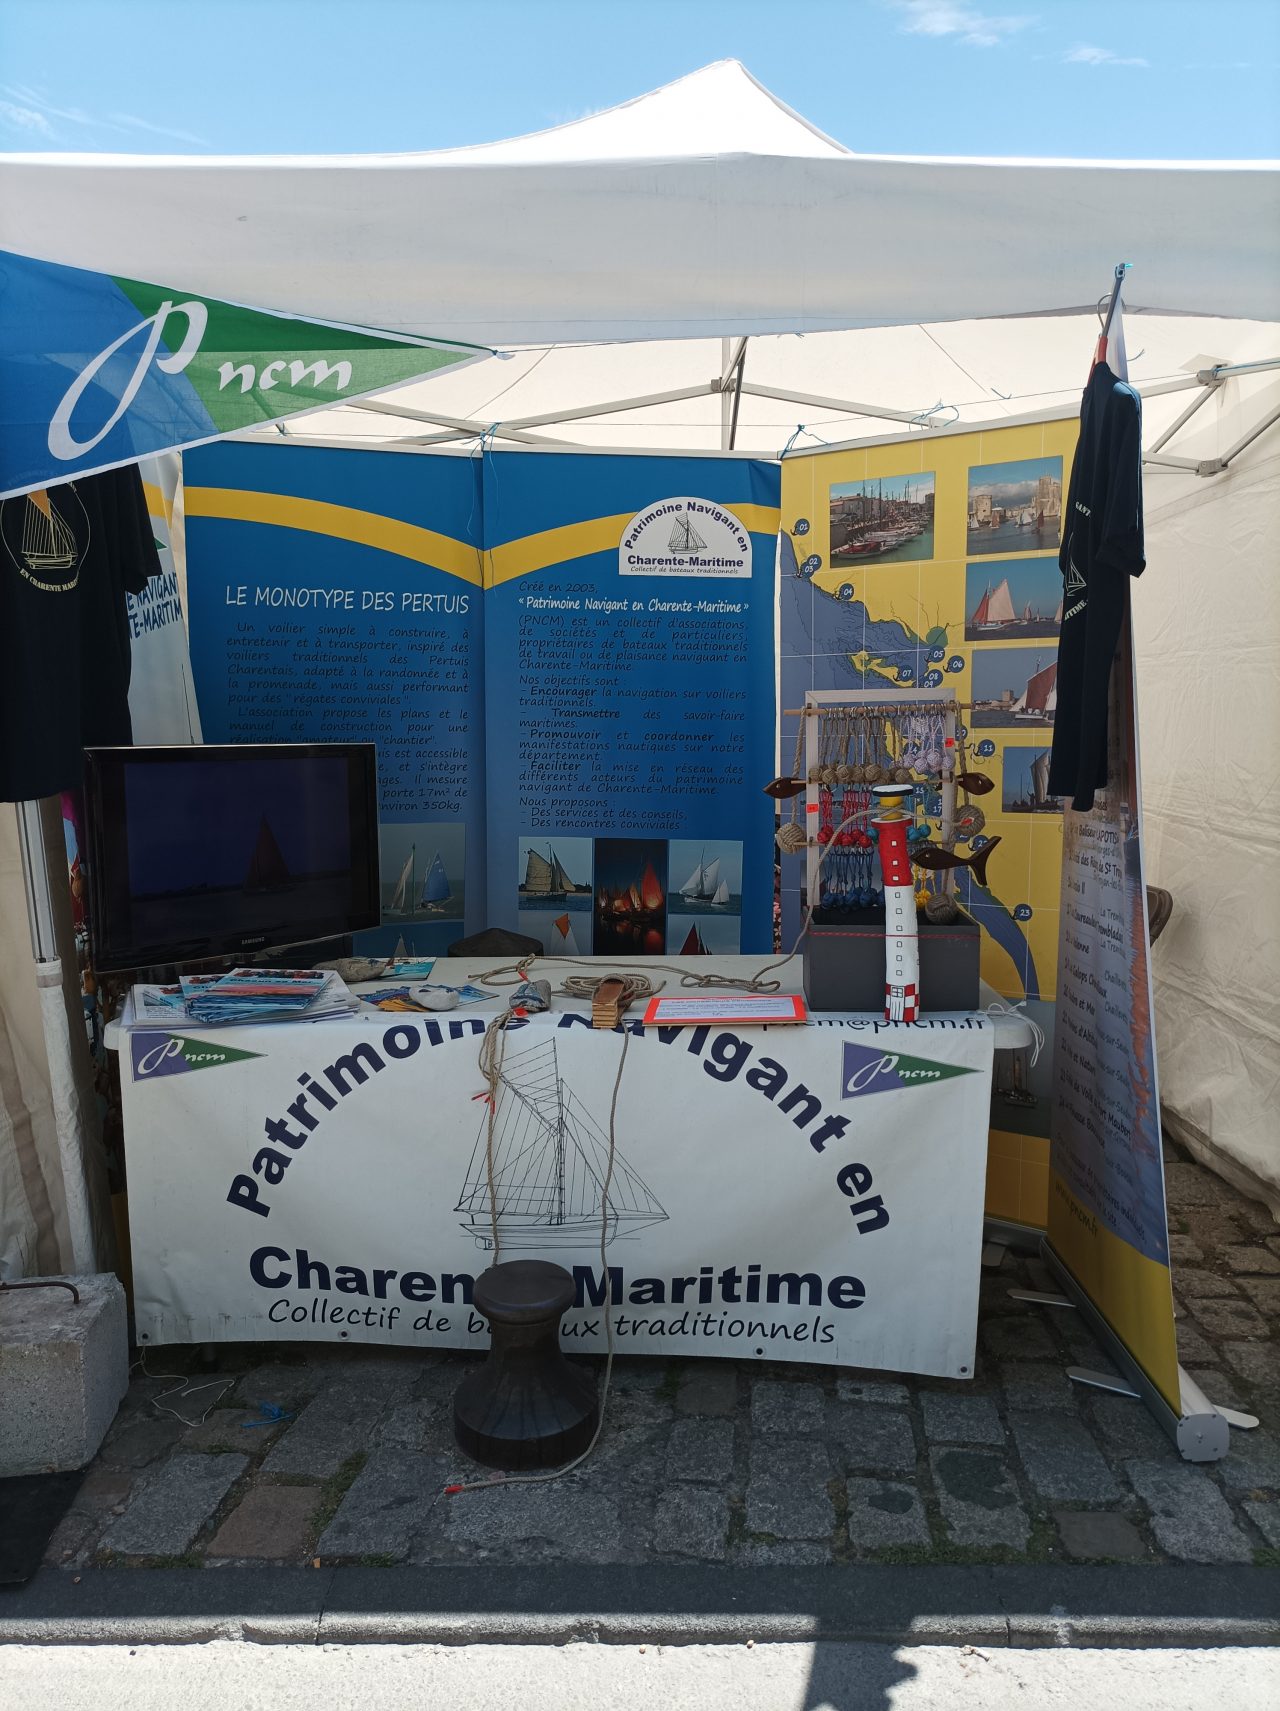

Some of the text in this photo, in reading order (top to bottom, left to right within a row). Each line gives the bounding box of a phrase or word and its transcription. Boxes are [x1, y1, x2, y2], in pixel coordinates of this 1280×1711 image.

[625, 502, 748, 552] Patrimoine Navigant en
[799, 523, 809, 531] 01
[628, 555, 744, 567] Charente-Maritime
[29, 576, 62, 592] CHARENTE
[136, 572, 177, 608] NAVIGAN
[519, 581, 544, 592] Créé
[844, 588, 853, 596] 04
[226, 586, 469, 613] LE MONOTYPE DES PERTUIS
[585, 599, 629, 613] Navigant
[518, 615, 565, 627] (PNCM)
[572, 618, 587, 626] est
[618, 618, 661, 628] collectif
[237, 622, 255, 632] Un
[269, 624, 306, 633] voilier
[318, 624, 356, 637] simple
[550, 627, 596, 637] sociétés
[227, 637, 290, 647] entretenir
[407, 642, 444, 654] inspiré
[451, 643, 469, 653] des
[519, 638, 748, 651] propriétaires bateaux traditionnels
[227, 651, 469, 666] voiliers traditionnels des Pertuis
[538, 649, 730, 664] travail plaisance naviguant
[304, 666, 344, 678] adapté
[380, 667, 439, 678] randonnée
[520, 674, 620, 687] Nos objectifs sont
[331, 681, 358, 690] mais
[367, 683, 393, 691] aussi
[402, 682, 469, 695] performant
[531, 686, 597, 699] Encourager
[618, 688, 677, 700] navigation
[706, 690, 746, 699] voiliers
[228, 695, 258, 705] pour
[263, 693, 281, 703] des
[238, 708, 430, 720] L'association propose les plans
[552, 709, 745, 720] Transmettre des savoir-faire
[229, 721, 468, 734] manuel construction pour une
[530, 729, 744, 742] Promouvoir coordonner les
[519, 739, 744, 753] manifestations nautiques sur notre
[395, 750, 411, 758] est
[415, 748, 468, 758] accessible
[420, 761, 468, 774] s'intègre
[531, 761, 743, 774] Faciliter mise réseau des
[519, 771, 743, 785] différents acteurs patrimoine
[383, 789, 415, 799] porte
[519, 782, 572, 794] navigant
[379, 802, 418, 811] nviron
[520, 797, 608, 809] Nous proposons
[531, 807, 550, 817] Des
[555, 808, 598, 818] services
[619, 808, 637, 819] des
[531, 818, 550, 828] Des
[555, 819, 616, 828] rencontres
[837, 1162, 890, 1235] en
[268, 1298, 401, 1329] Collectif
[413, 1309, 452, 1333] de
[614, 1310, 835, 1345] traditionnels
